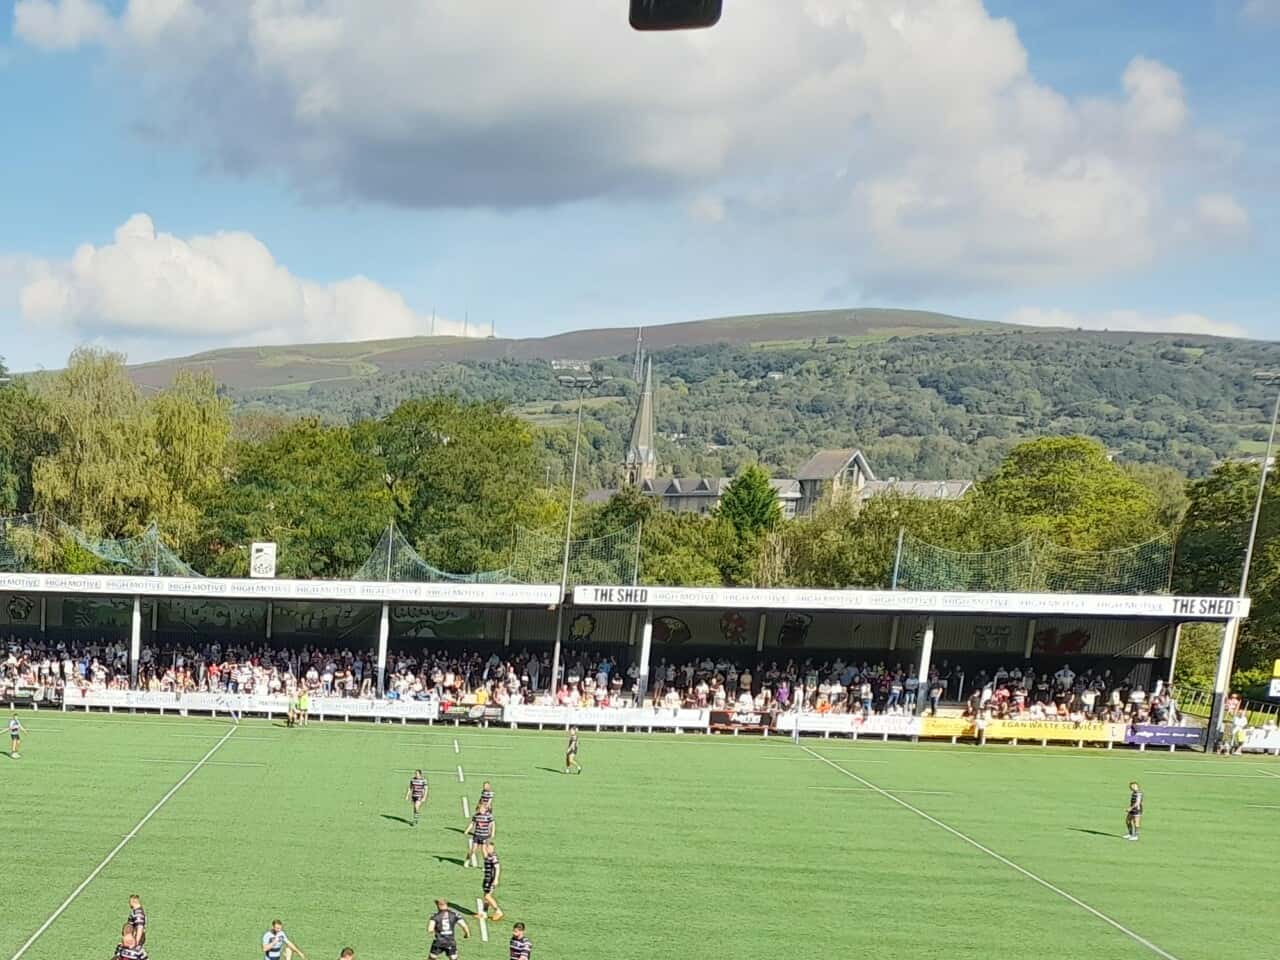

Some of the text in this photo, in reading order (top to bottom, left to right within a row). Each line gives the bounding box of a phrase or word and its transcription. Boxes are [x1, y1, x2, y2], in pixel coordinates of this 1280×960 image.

[7, 579, 39, 587] MOTIVE
[169, 583, 225, 592] HIGH MOTIVE
[593, 588, 649, 603] THE SHED
[1172, 599, 1235, 615] THE SHED
[1001, 720, 1028, 729] EGAN
